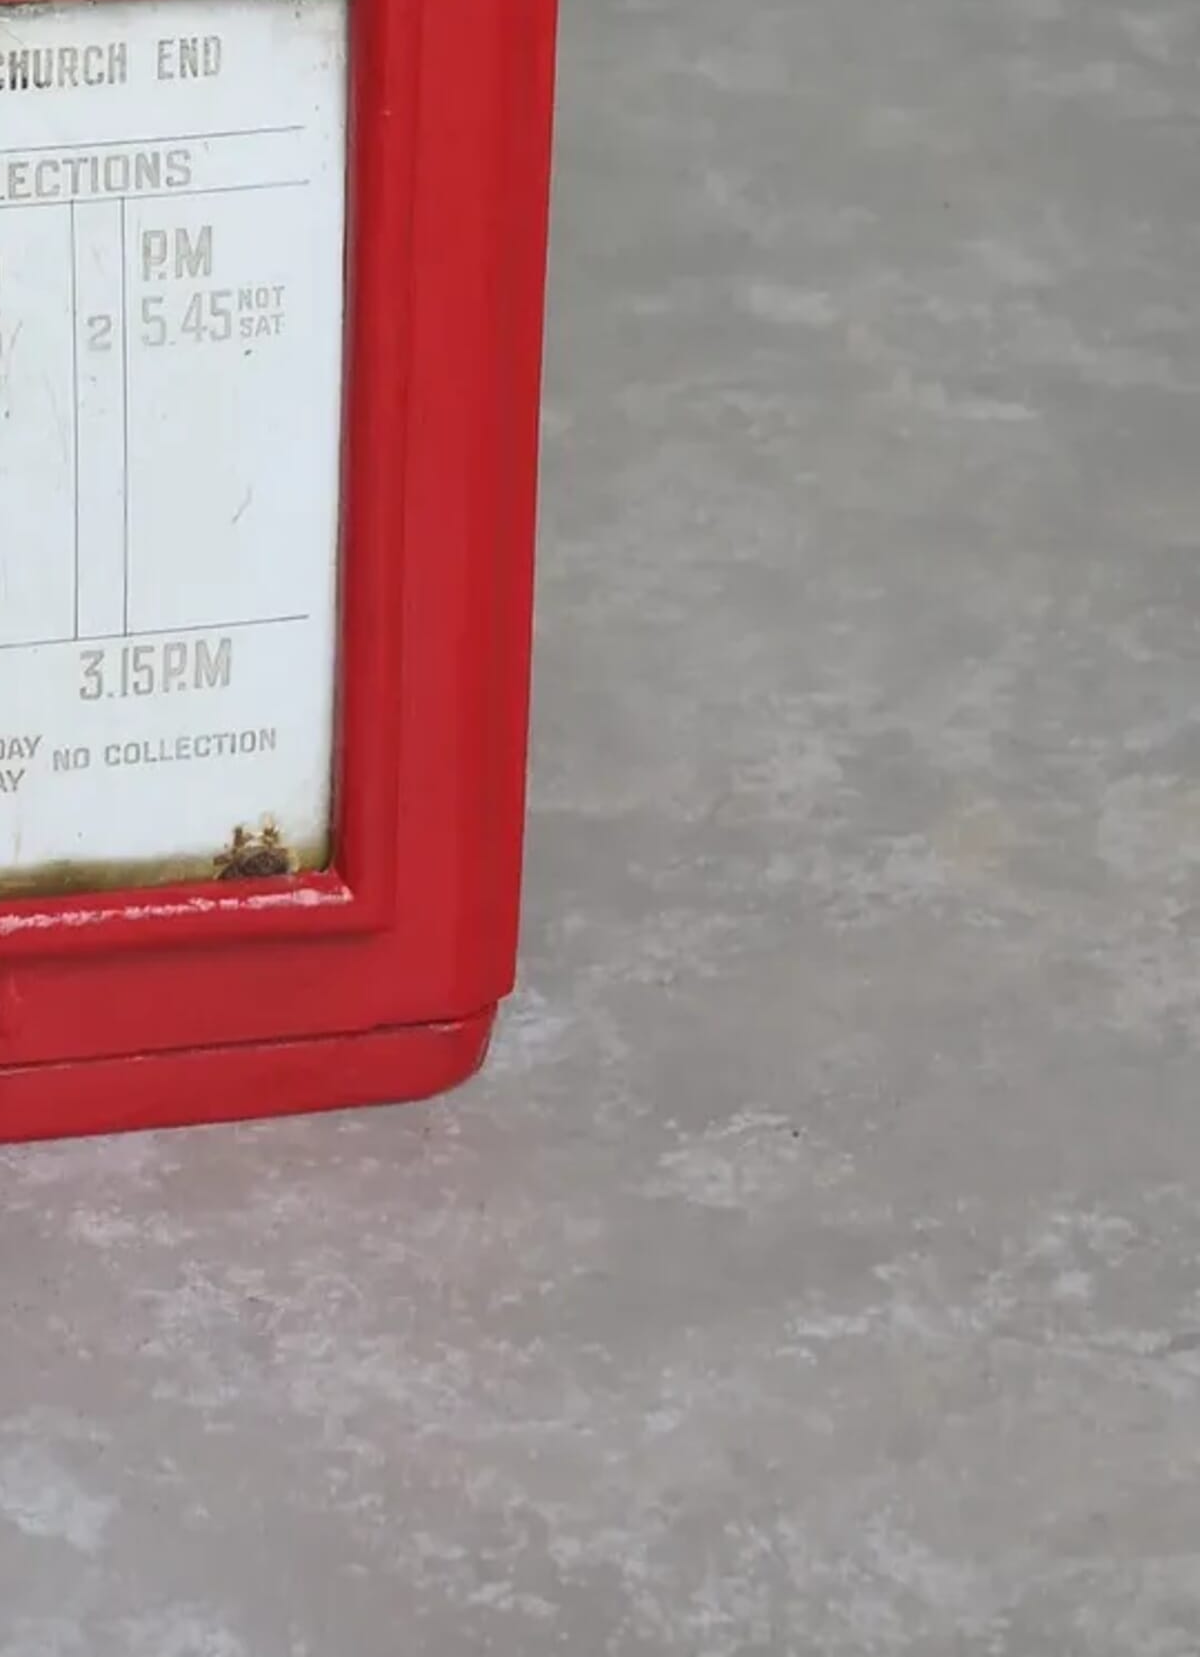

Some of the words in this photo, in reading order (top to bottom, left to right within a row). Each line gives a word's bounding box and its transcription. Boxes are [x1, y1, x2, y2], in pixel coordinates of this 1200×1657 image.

[157, 35, 222, 81] END
[141, 289, 232, 347] 5.45
[237, 285, 285, 312] NOT
[86, 314, 113, 352] 2
[239, 313, 285, 339] SAT
[52, 746, 91, 773] NO
[103, 727, 278, 768] COLLECTION
